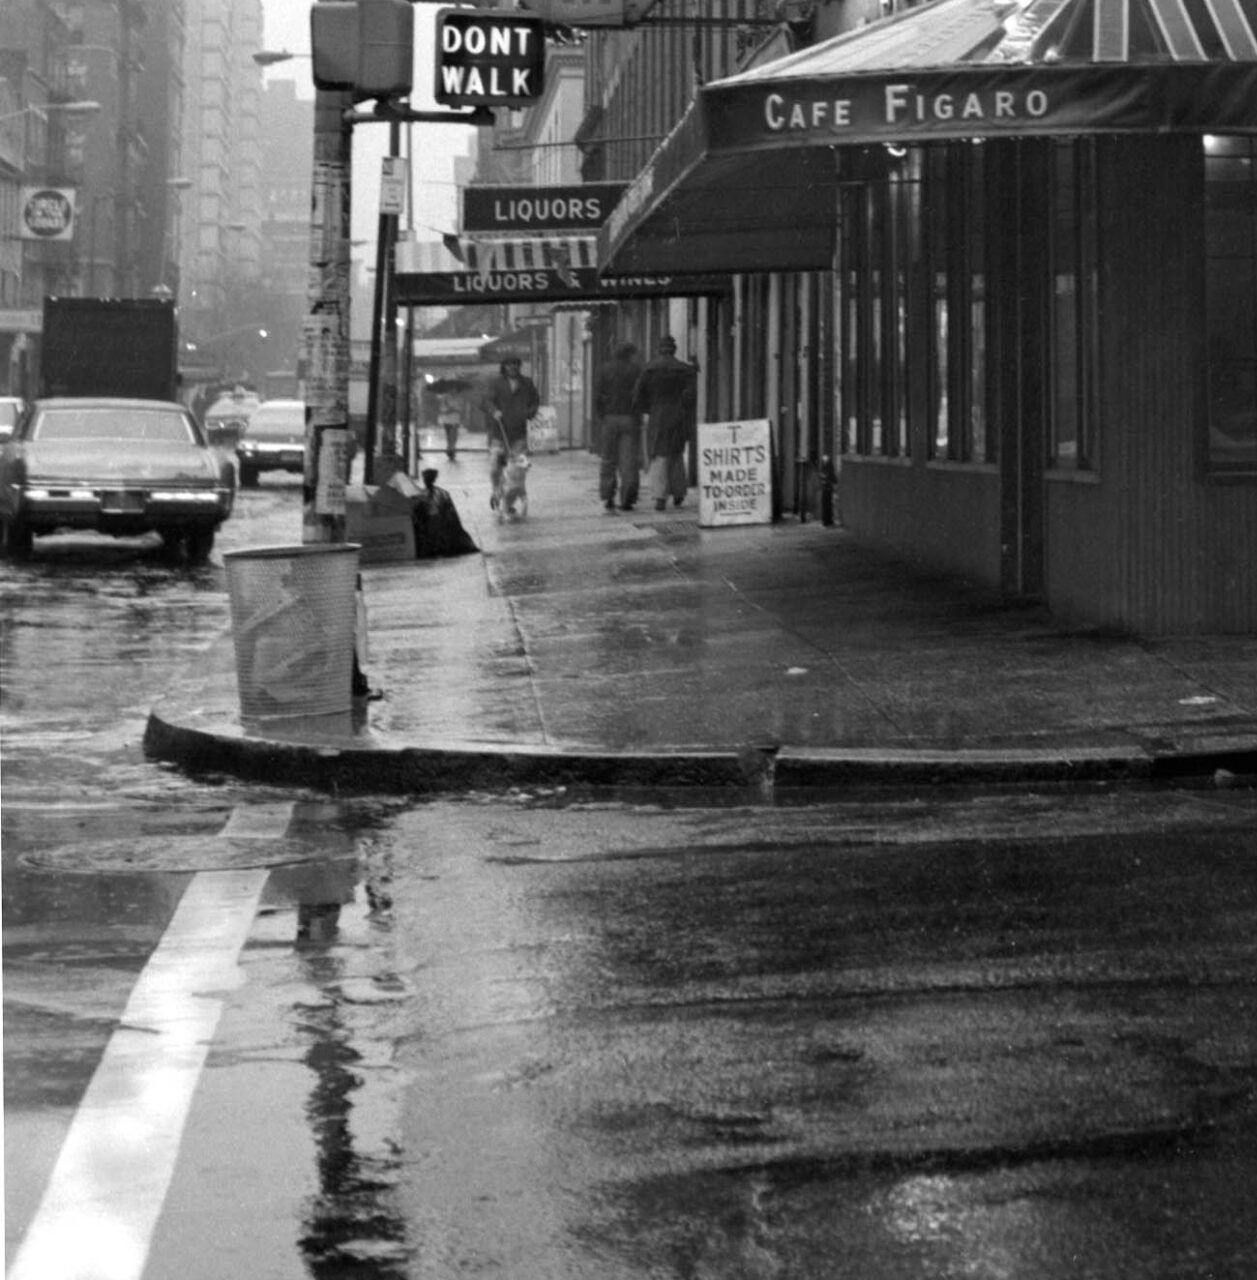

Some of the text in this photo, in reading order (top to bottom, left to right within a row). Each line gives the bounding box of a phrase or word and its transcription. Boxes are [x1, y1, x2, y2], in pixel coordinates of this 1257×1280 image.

[442, 25, 533, 56] DONT
[441, 65, 532, 96] WALK
[765, 84, 1049, 131] CAFE FIGARO
[494, 198, 601, 223] LIQUORS
[453, 272, 550, 293] LIQUORS
[727, 425, 742, 445] T
[703, 445, 765, 467] SHIRTS
[710, 468, 758, 483] MADE
[713, 499, 757, 513] INSIDE
